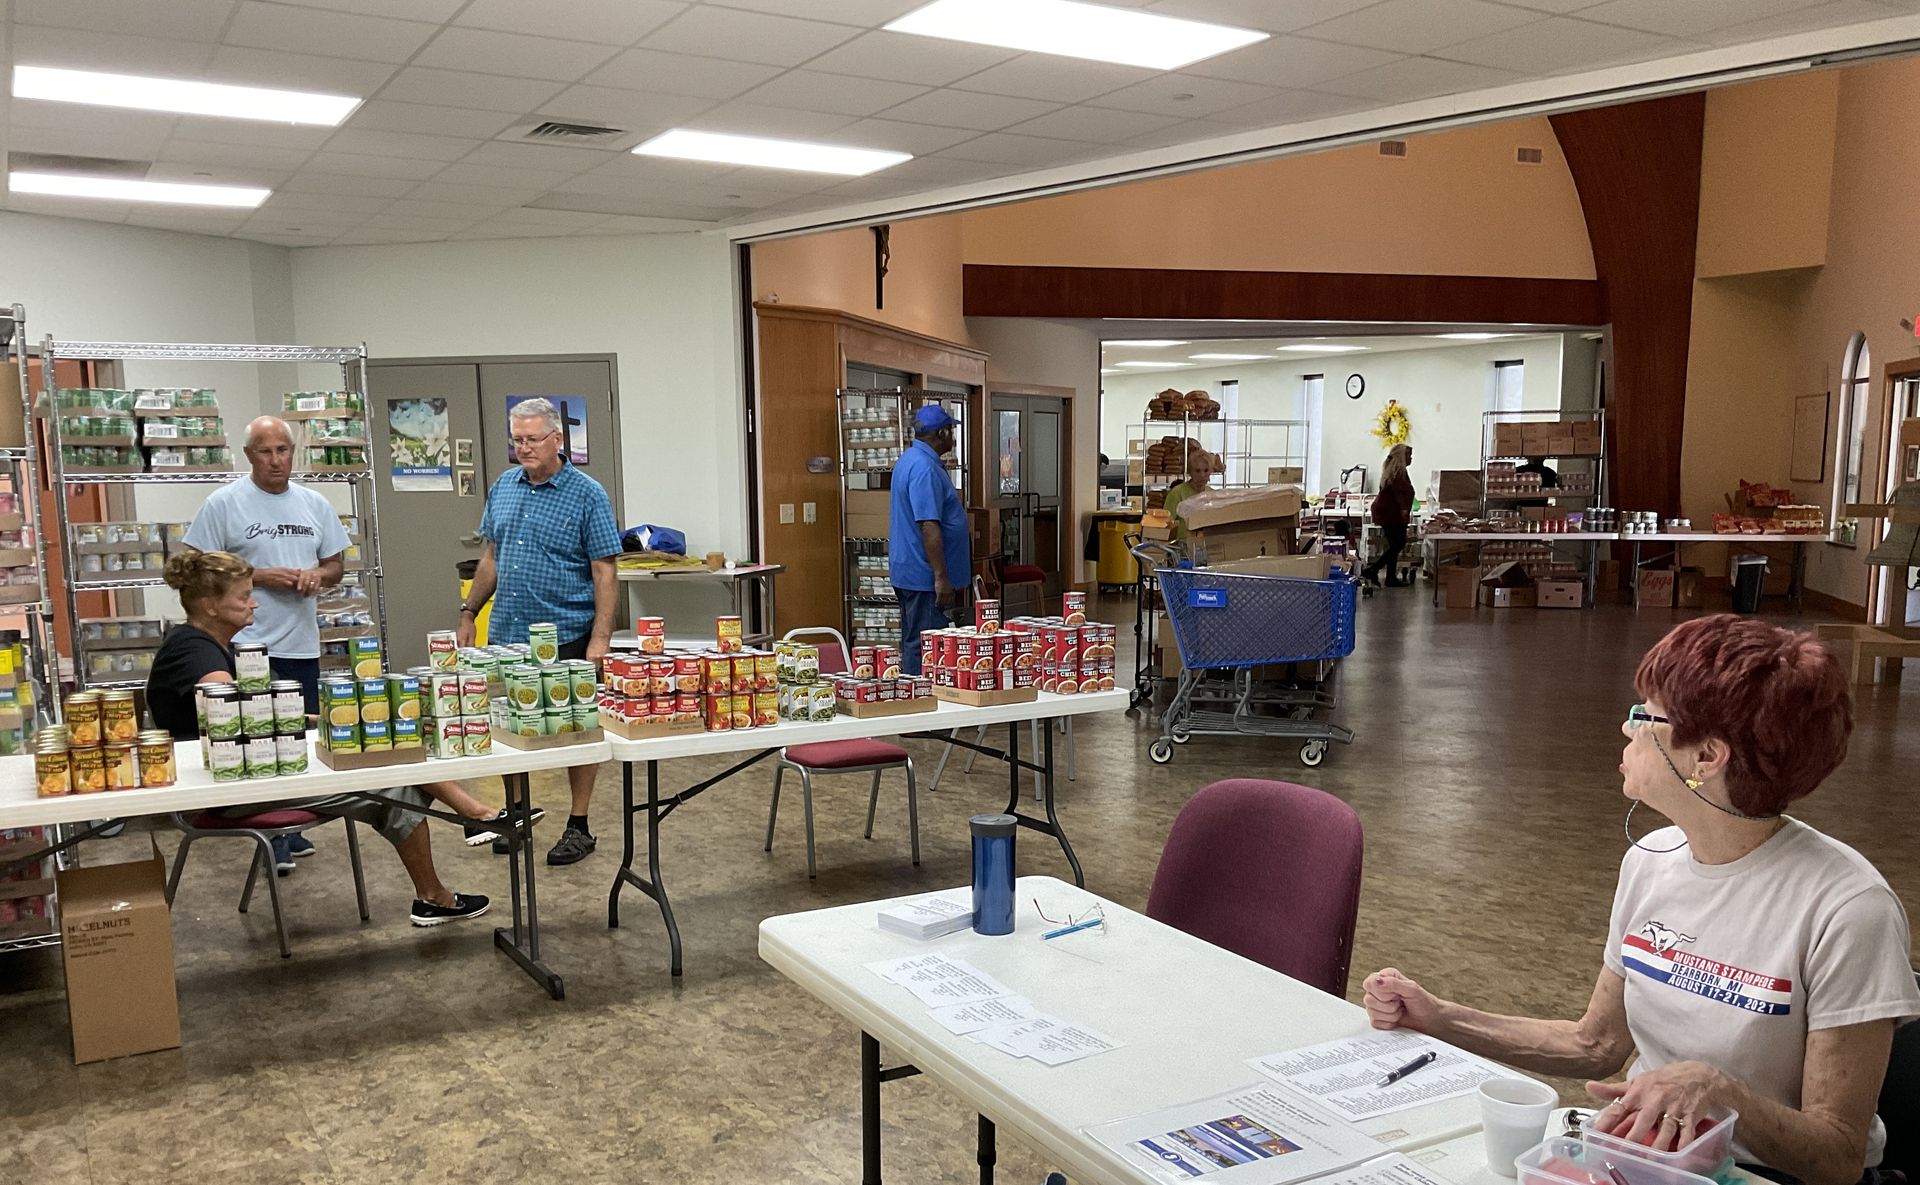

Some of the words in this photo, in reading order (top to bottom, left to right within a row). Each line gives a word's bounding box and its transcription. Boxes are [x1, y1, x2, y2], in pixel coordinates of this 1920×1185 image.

[67, 917, 131, 933] HZELNUTS
[1671, 963, 1722, 987] DEARBORN,
[1726, 980, 1744, 993] MI
[1673, 951, 1720, 974] MUSTANG
[1721, 965, 1776, 990] STAMPEDE
[1667, 974, 1707, 995] AUGUST
[1707, 987, 1741, 1008] 17-21,
[1744, 998, 1775, 1015] 2021
